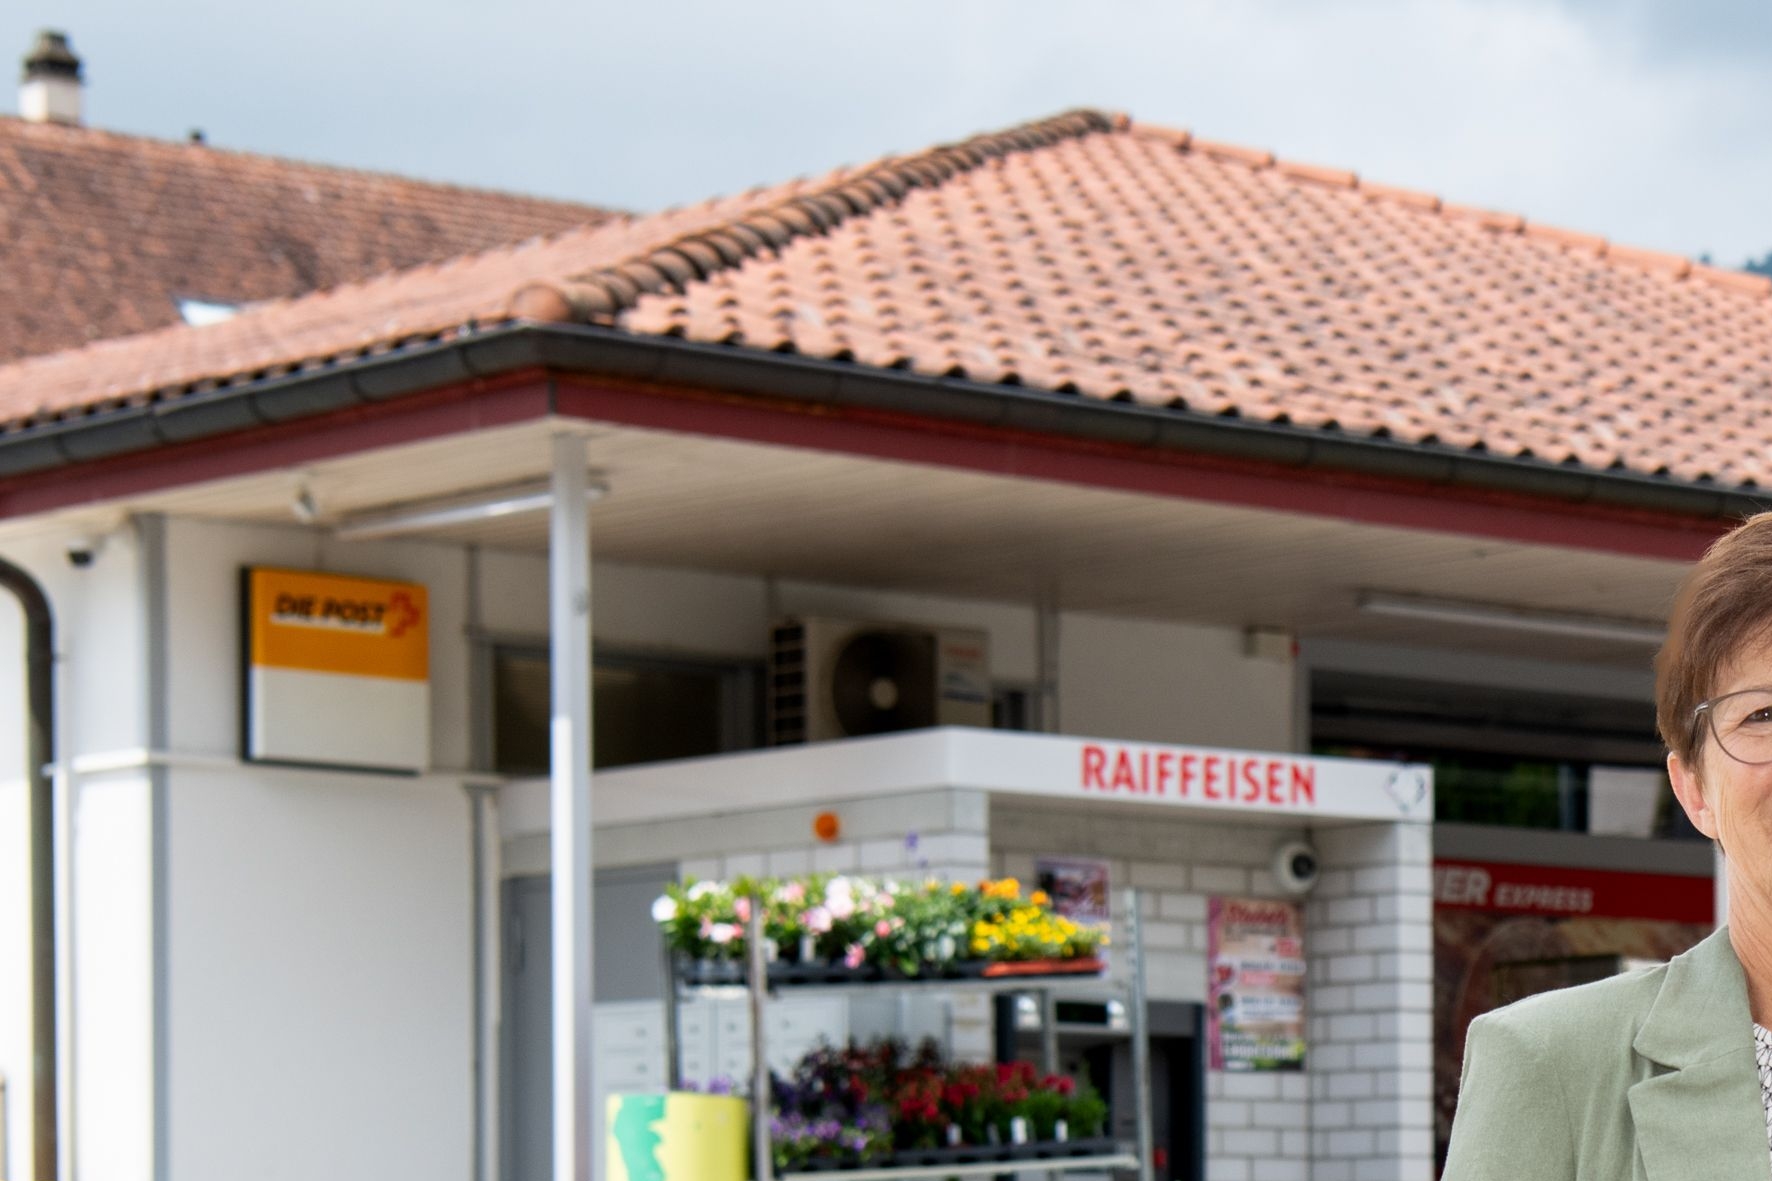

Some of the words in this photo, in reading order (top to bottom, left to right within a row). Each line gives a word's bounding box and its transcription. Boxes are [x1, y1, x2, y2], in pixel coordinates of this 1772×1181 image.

[274, 593, 315, 620] DIE
[322, 596, 386, 627] POST
[1081, 742, 1316, 805] RAIFFEISEN
[1494, 882, 1594, 913] EXPRESS
